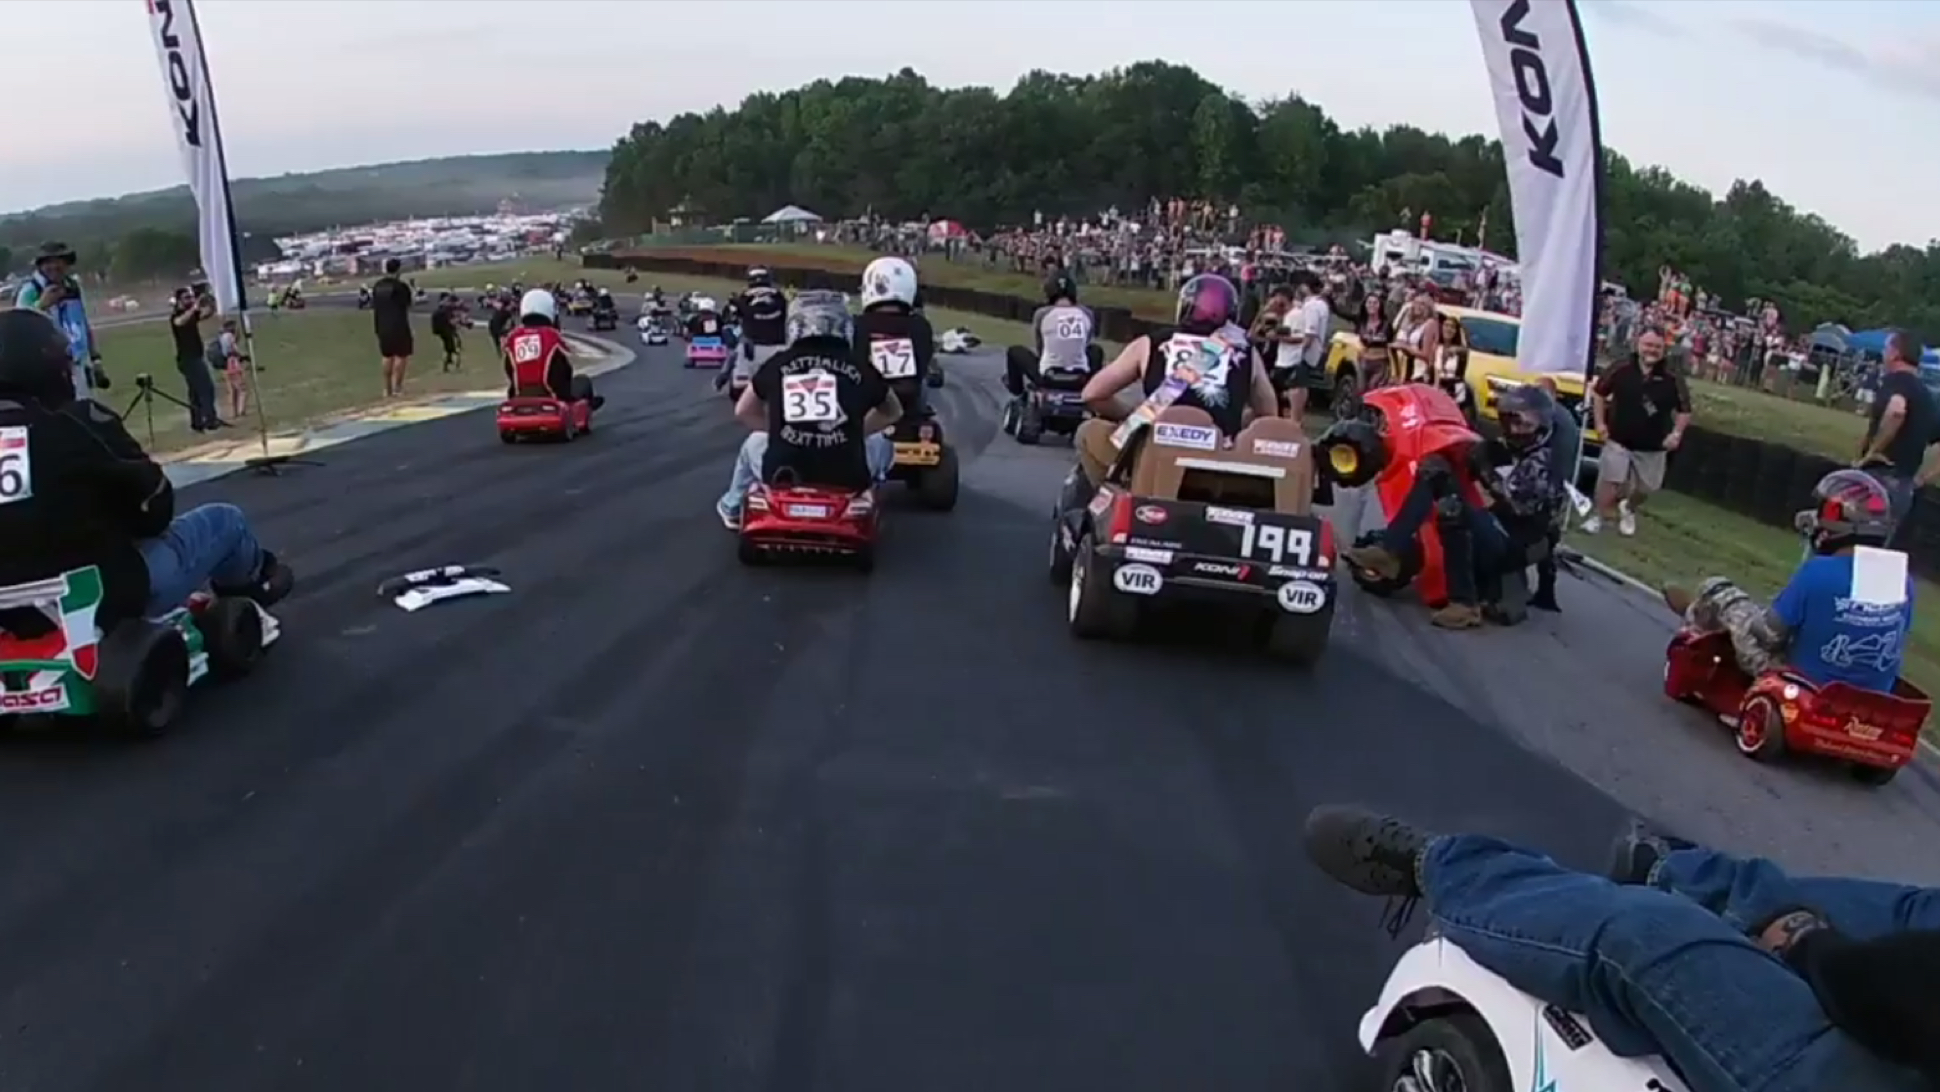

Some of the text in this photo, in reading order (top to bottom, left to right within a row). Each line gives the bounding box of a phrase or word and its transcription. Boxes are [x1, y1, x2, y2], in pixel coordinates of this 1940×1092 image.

[148, 0, 201, 147] KON
[1060, 323, 1082, 338] 04
[518, 342, 539, 359] 09
[879, 352, 911, 375] 17
[790, 391, 831, 417] 35
[815, 430, 849, 448] TIME
[1157, 425, 1213, 441] EXEDY
[1122, 571, 1155, 589] VIR
[1286, 588, 1317, 606] VIR
[0, 686, 61, 708] asa
